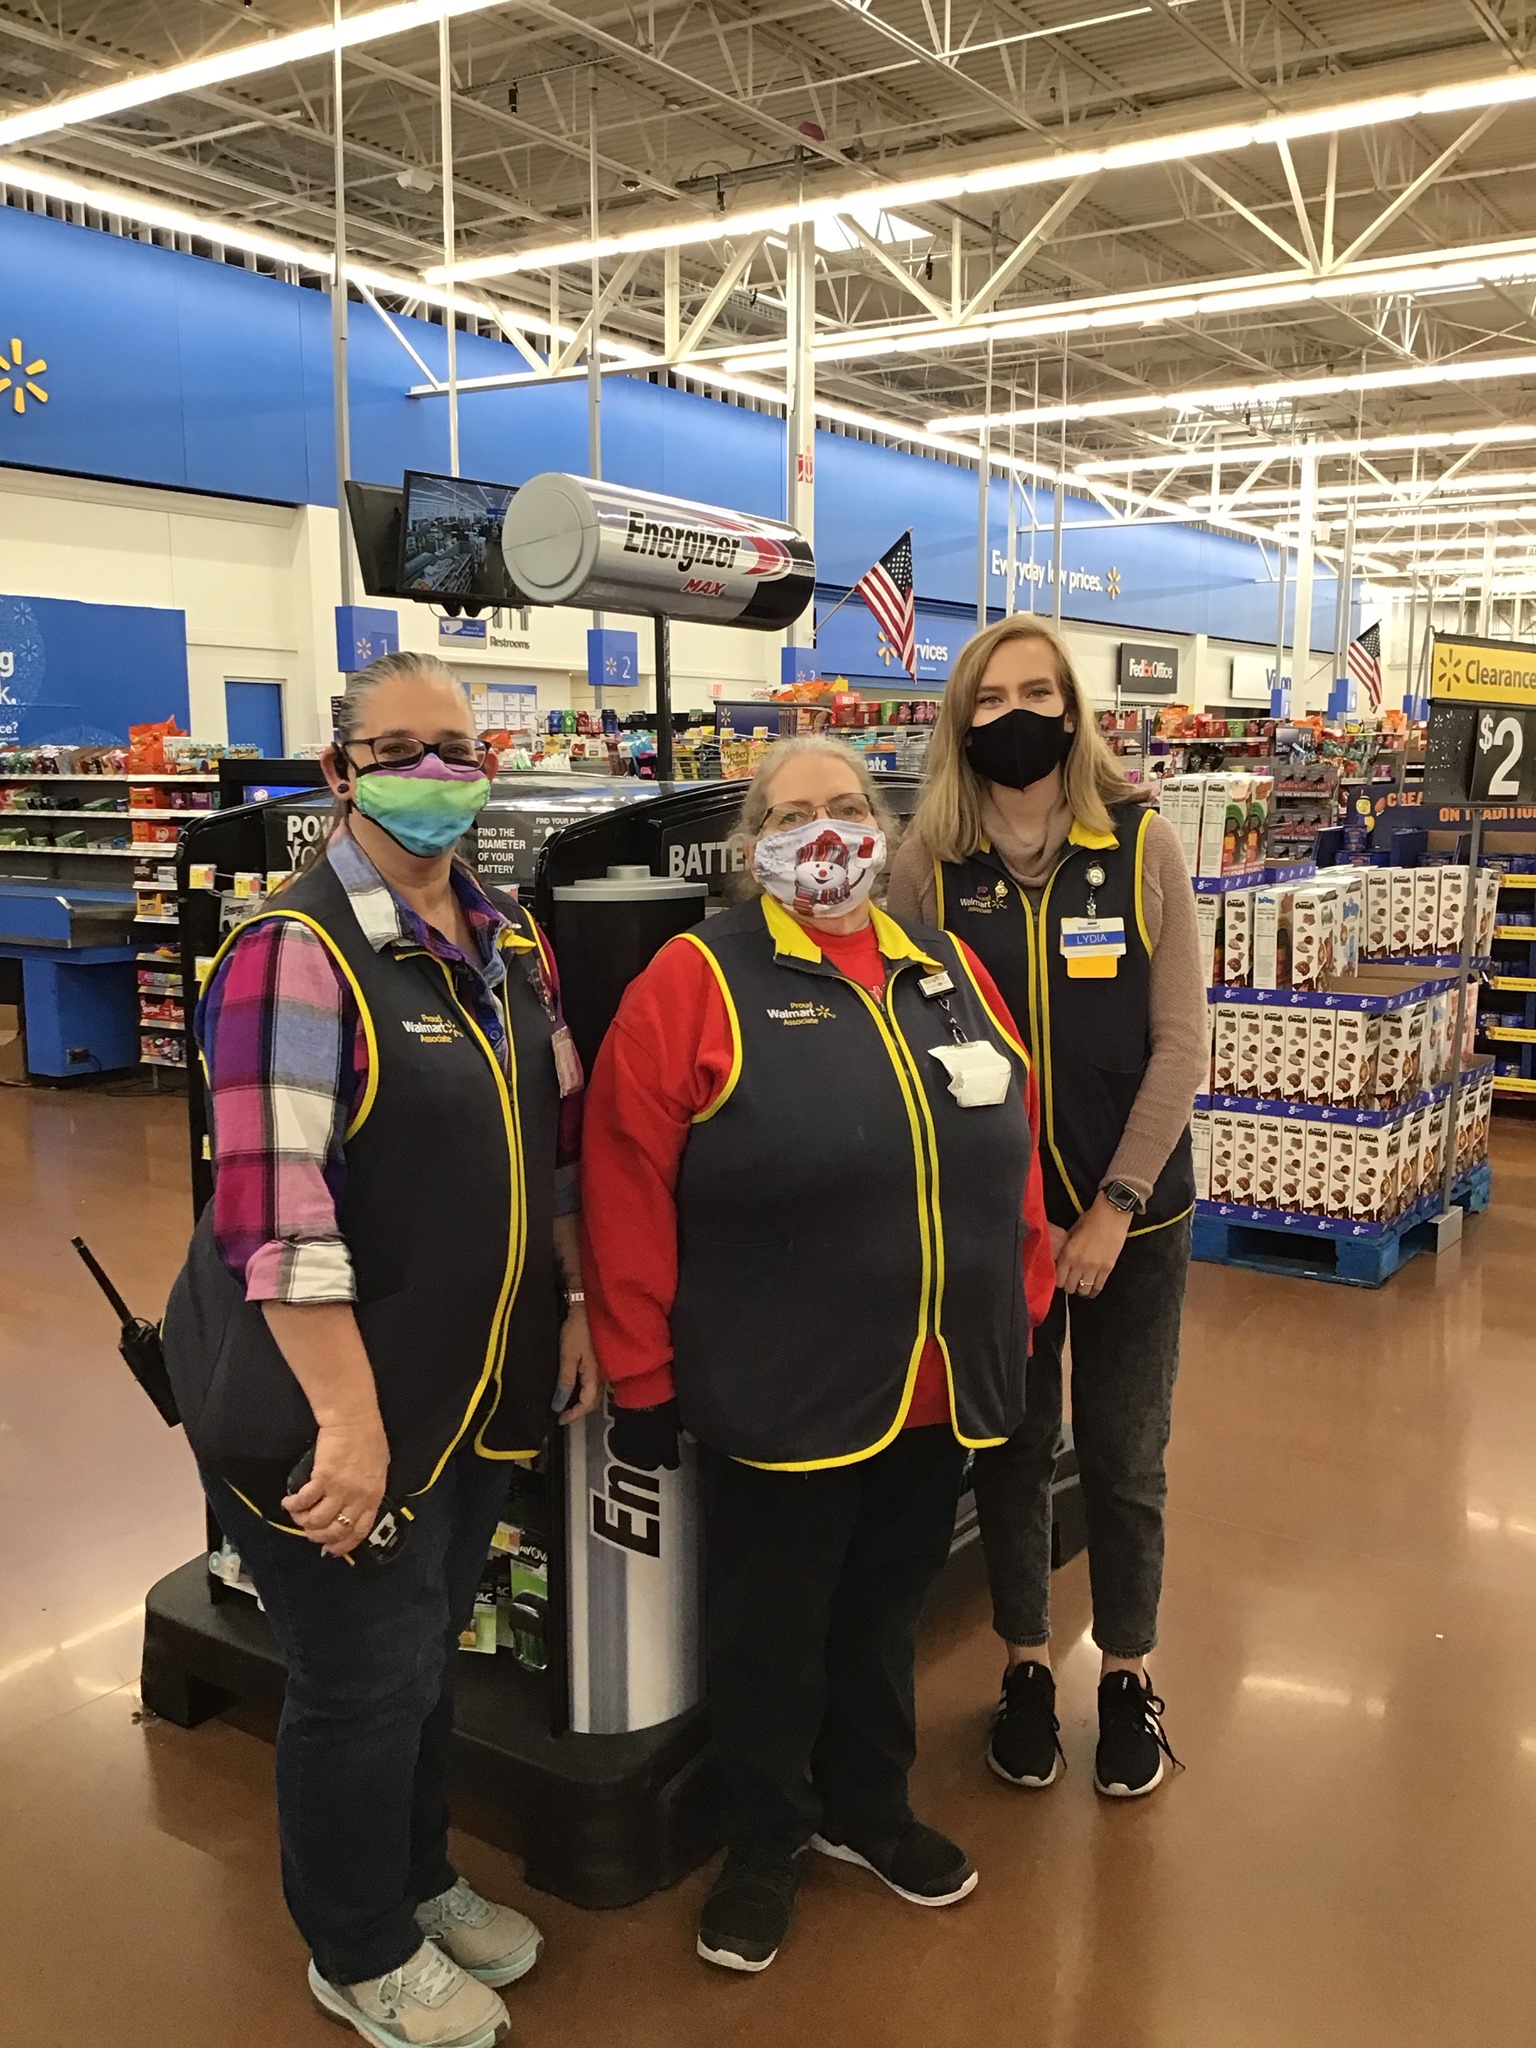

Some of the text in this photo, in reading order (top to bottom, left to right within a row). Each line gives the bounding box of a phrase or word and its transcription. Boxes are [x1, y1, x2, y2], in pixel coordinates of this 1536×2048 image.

[623, 510, 741, 572] Energizer
[991, 549, 1103, 594] Evryday lw prices.
[682, 578, 727, 596] MAX
[380, 638, 388, 656] 1
[489, 635, 530, 649] Restrooms
[914, 638, 948, 661] rvices
[622, 655, 631, 679] 2
[1129, 657, 1173, 679] FedEx Office
[1266, 668, 1292, 691] Vion
[1465, 659, 1536, 690] Clearance
[551, 817, 569, 825] YOUR
[1439, 807, 1460, 822] ON
[477, 827, 515, 837] FIND THE
[477, 839, 526, 850] DIAMETER
[477, 852, 514, 862] OF YOUR
[669, 841, 750, 879] BATTE
[477, 864, 515, 874] BATTERY
[960, 897, 992, 909] Walmart
[1076, 933, 1108, 945] LYDIA
[789, 1001, 814, 1009] Proud
[766, 1008, 817, 1019] Walmart
[401, 1020, 449, 1034] Walmart
